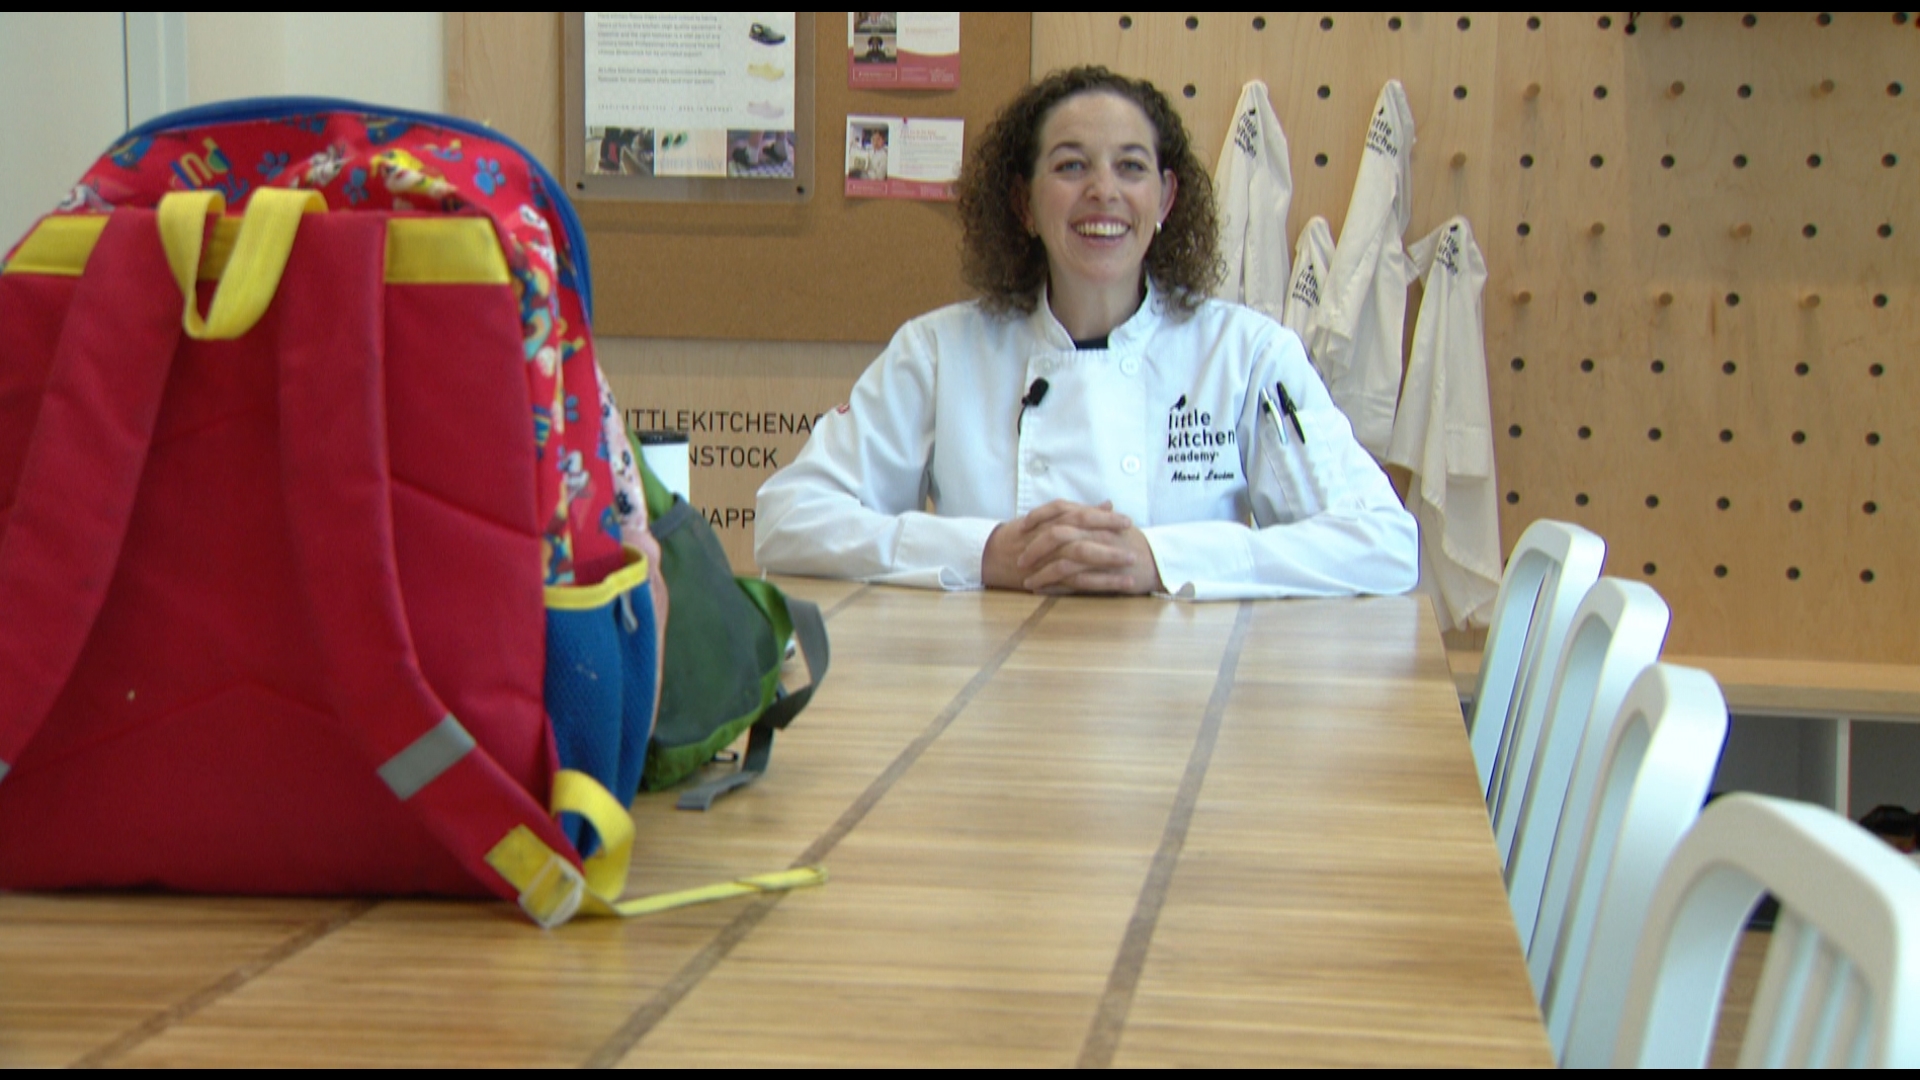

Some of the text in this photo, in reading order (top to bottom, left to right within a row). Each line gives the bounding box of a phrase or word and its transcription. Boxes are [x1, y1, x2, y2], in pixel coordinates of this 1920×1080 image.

[1168, 408, 1211, 430] little
[1168, 427, 1235, 450] kitchen
[1168, 450, 1215, 464] academy
[702, 506, 756, 529] APP
